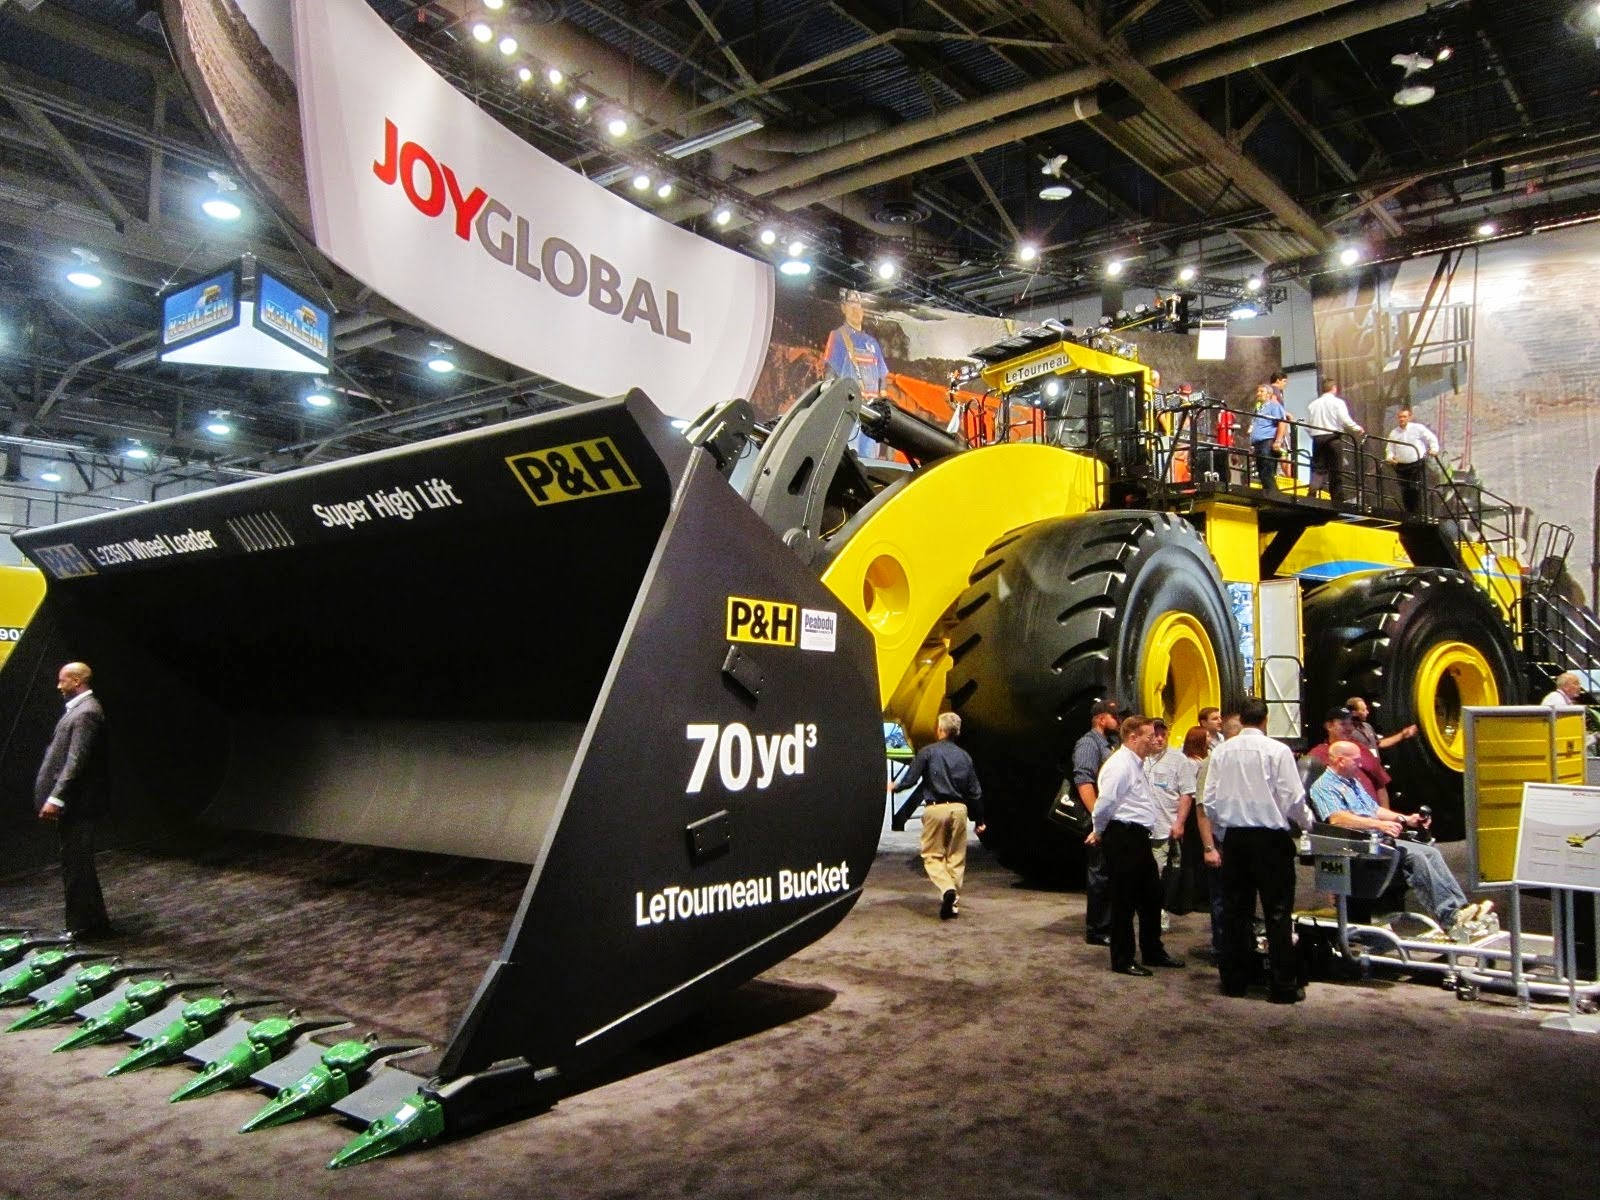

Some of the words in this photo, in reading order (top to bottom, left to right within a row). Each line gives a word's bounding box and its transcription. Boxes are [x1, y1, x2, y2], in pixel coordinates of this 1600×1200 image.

[1005, 354, 1069, 384] LeTourneau
[511, 440, 636, 503] P&H
[312, 499, 374, 530] Super
[366, 486, 420, 521] High
[415, 477, 463, 509] Lift
[88, 542, 133, 567] L-2350
[124, 534, 173, 560] Wheel
[163, 528, 218, 554] Loader
[0, 628, 24, 641] 90
[730, 600, 794, 643] P&H
[804, 613, 834, 636] Peabody
[635, 876, 772, 927] LeTourneau
[779, 860, 850, 901] Bucket
